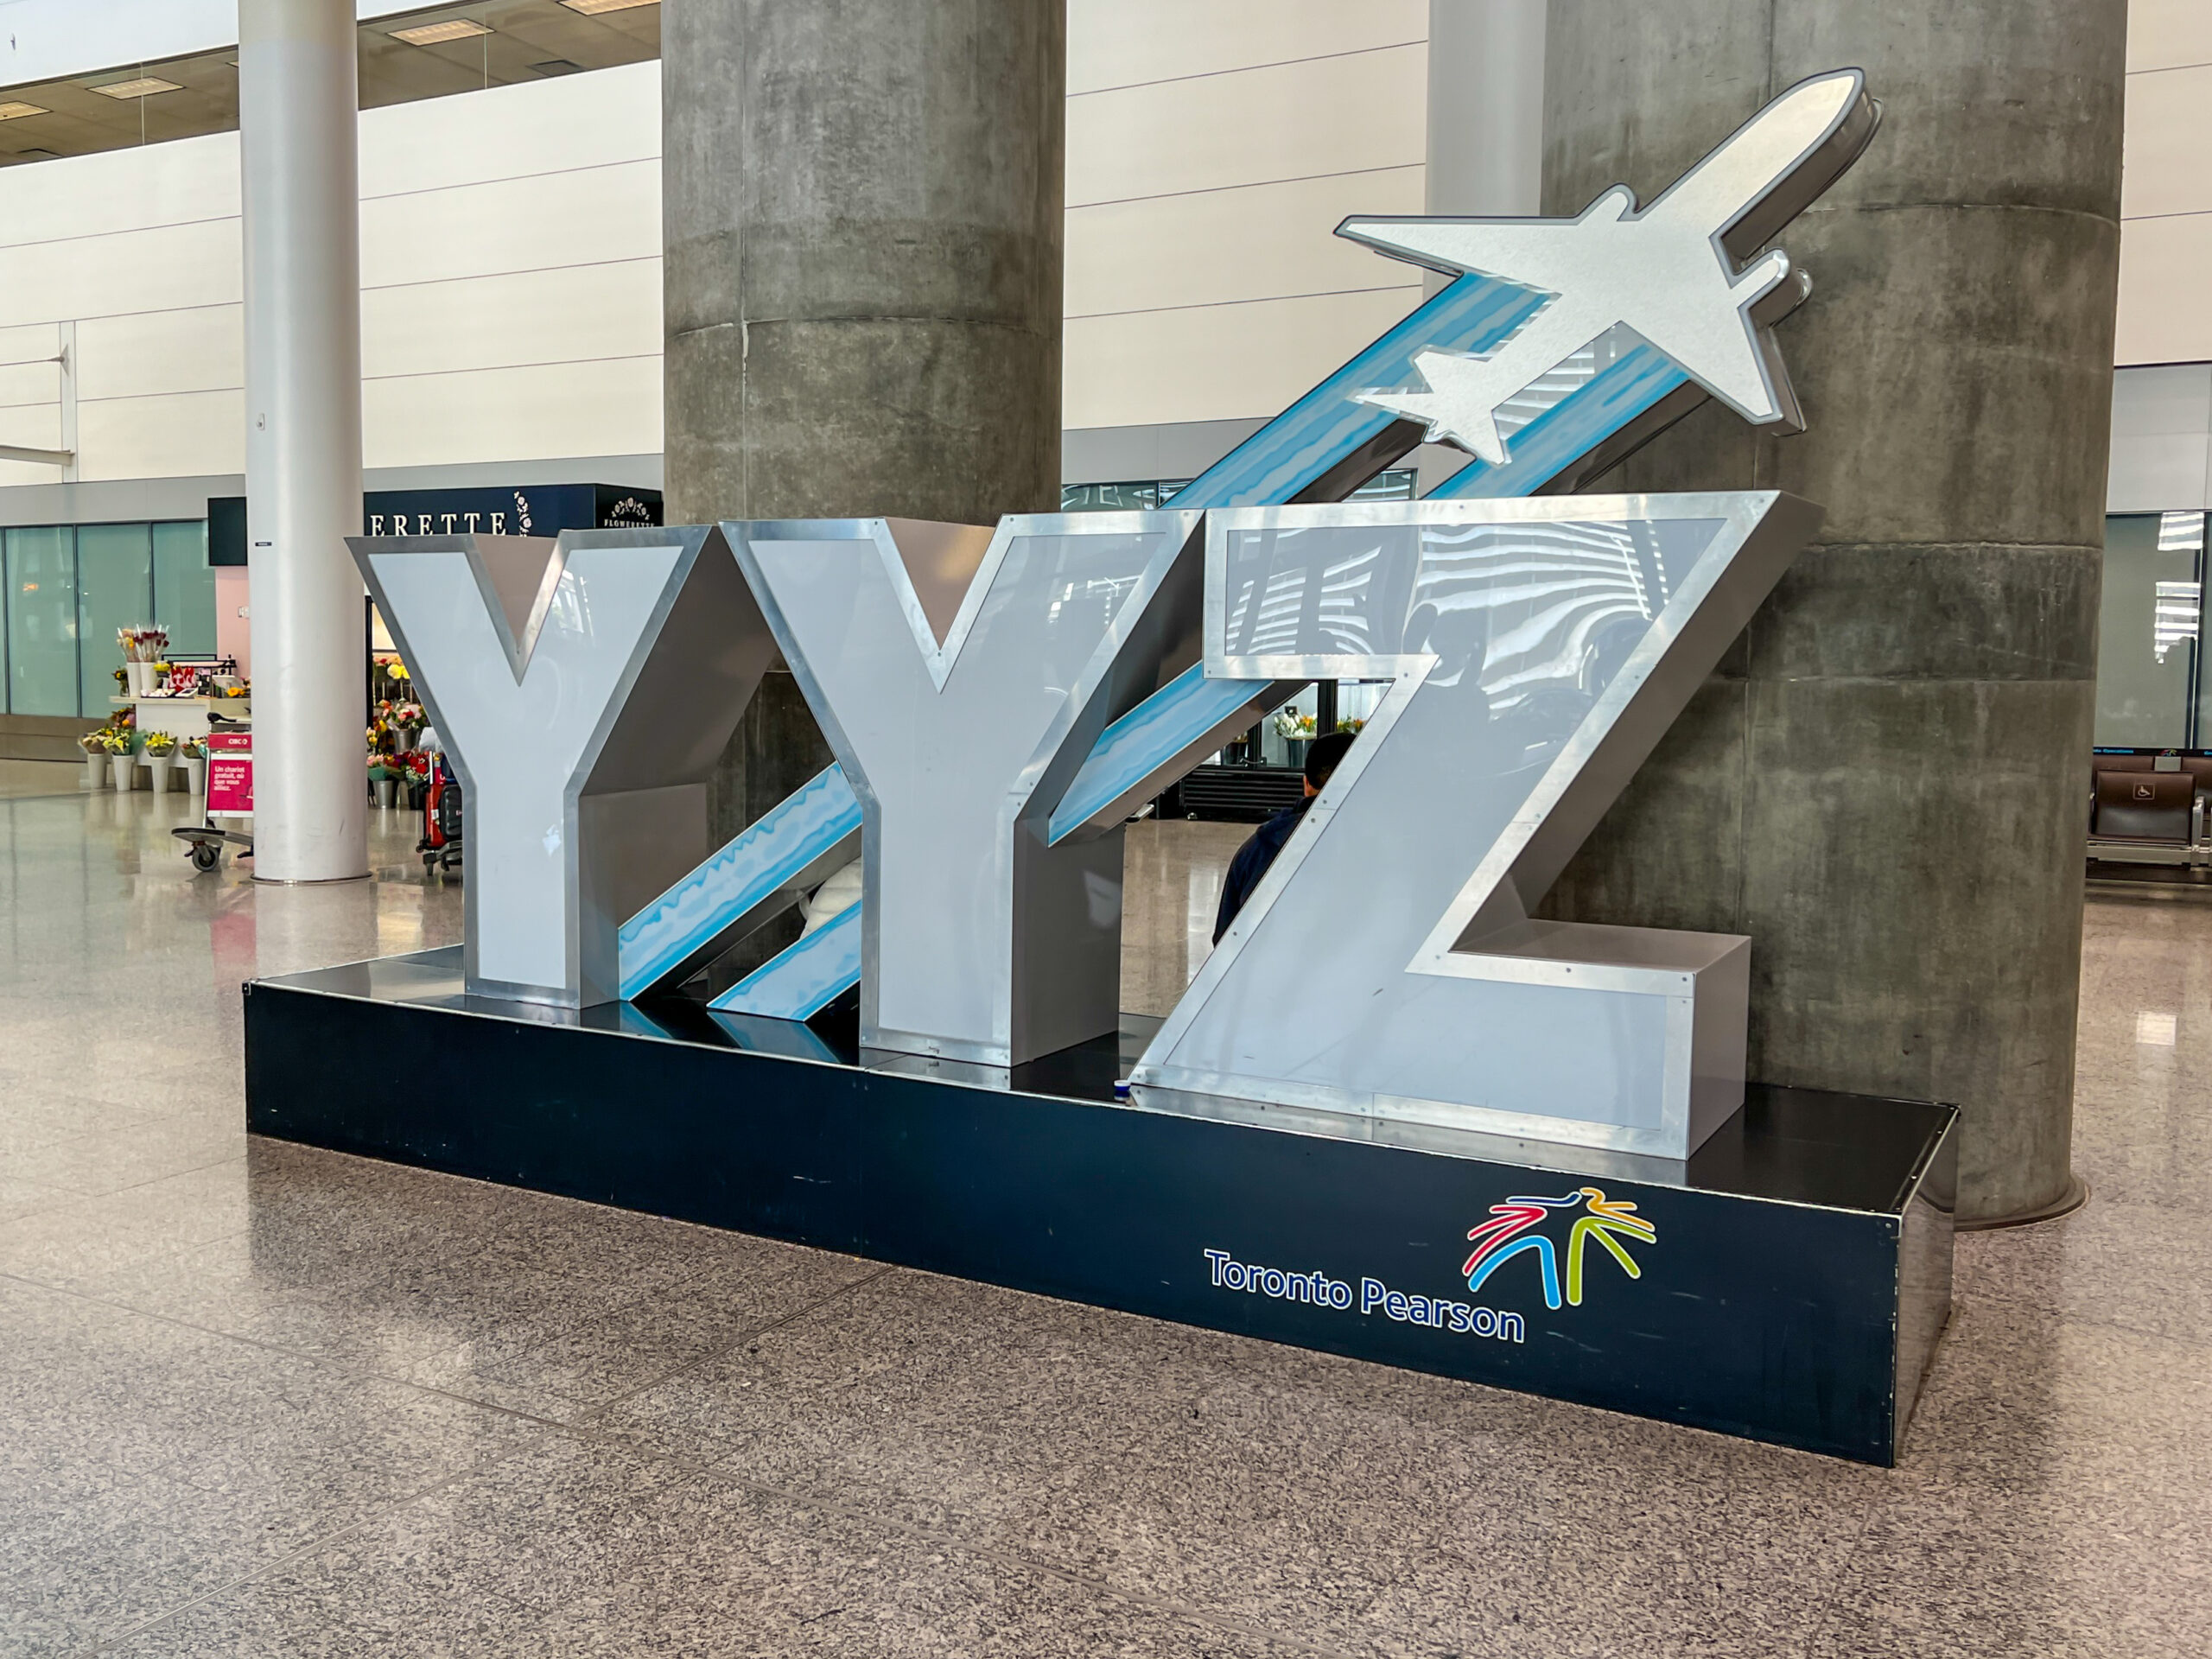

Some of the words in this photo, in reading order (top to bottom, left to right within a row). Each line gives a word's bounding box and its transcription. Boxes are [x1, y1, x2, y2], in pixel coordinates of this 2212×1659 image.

[347, 490, 1784, 1160] YYZ
[1204, 1249, 1352, 1310] Toronto
[1360, 1276, 1525, 1344] Pearson
